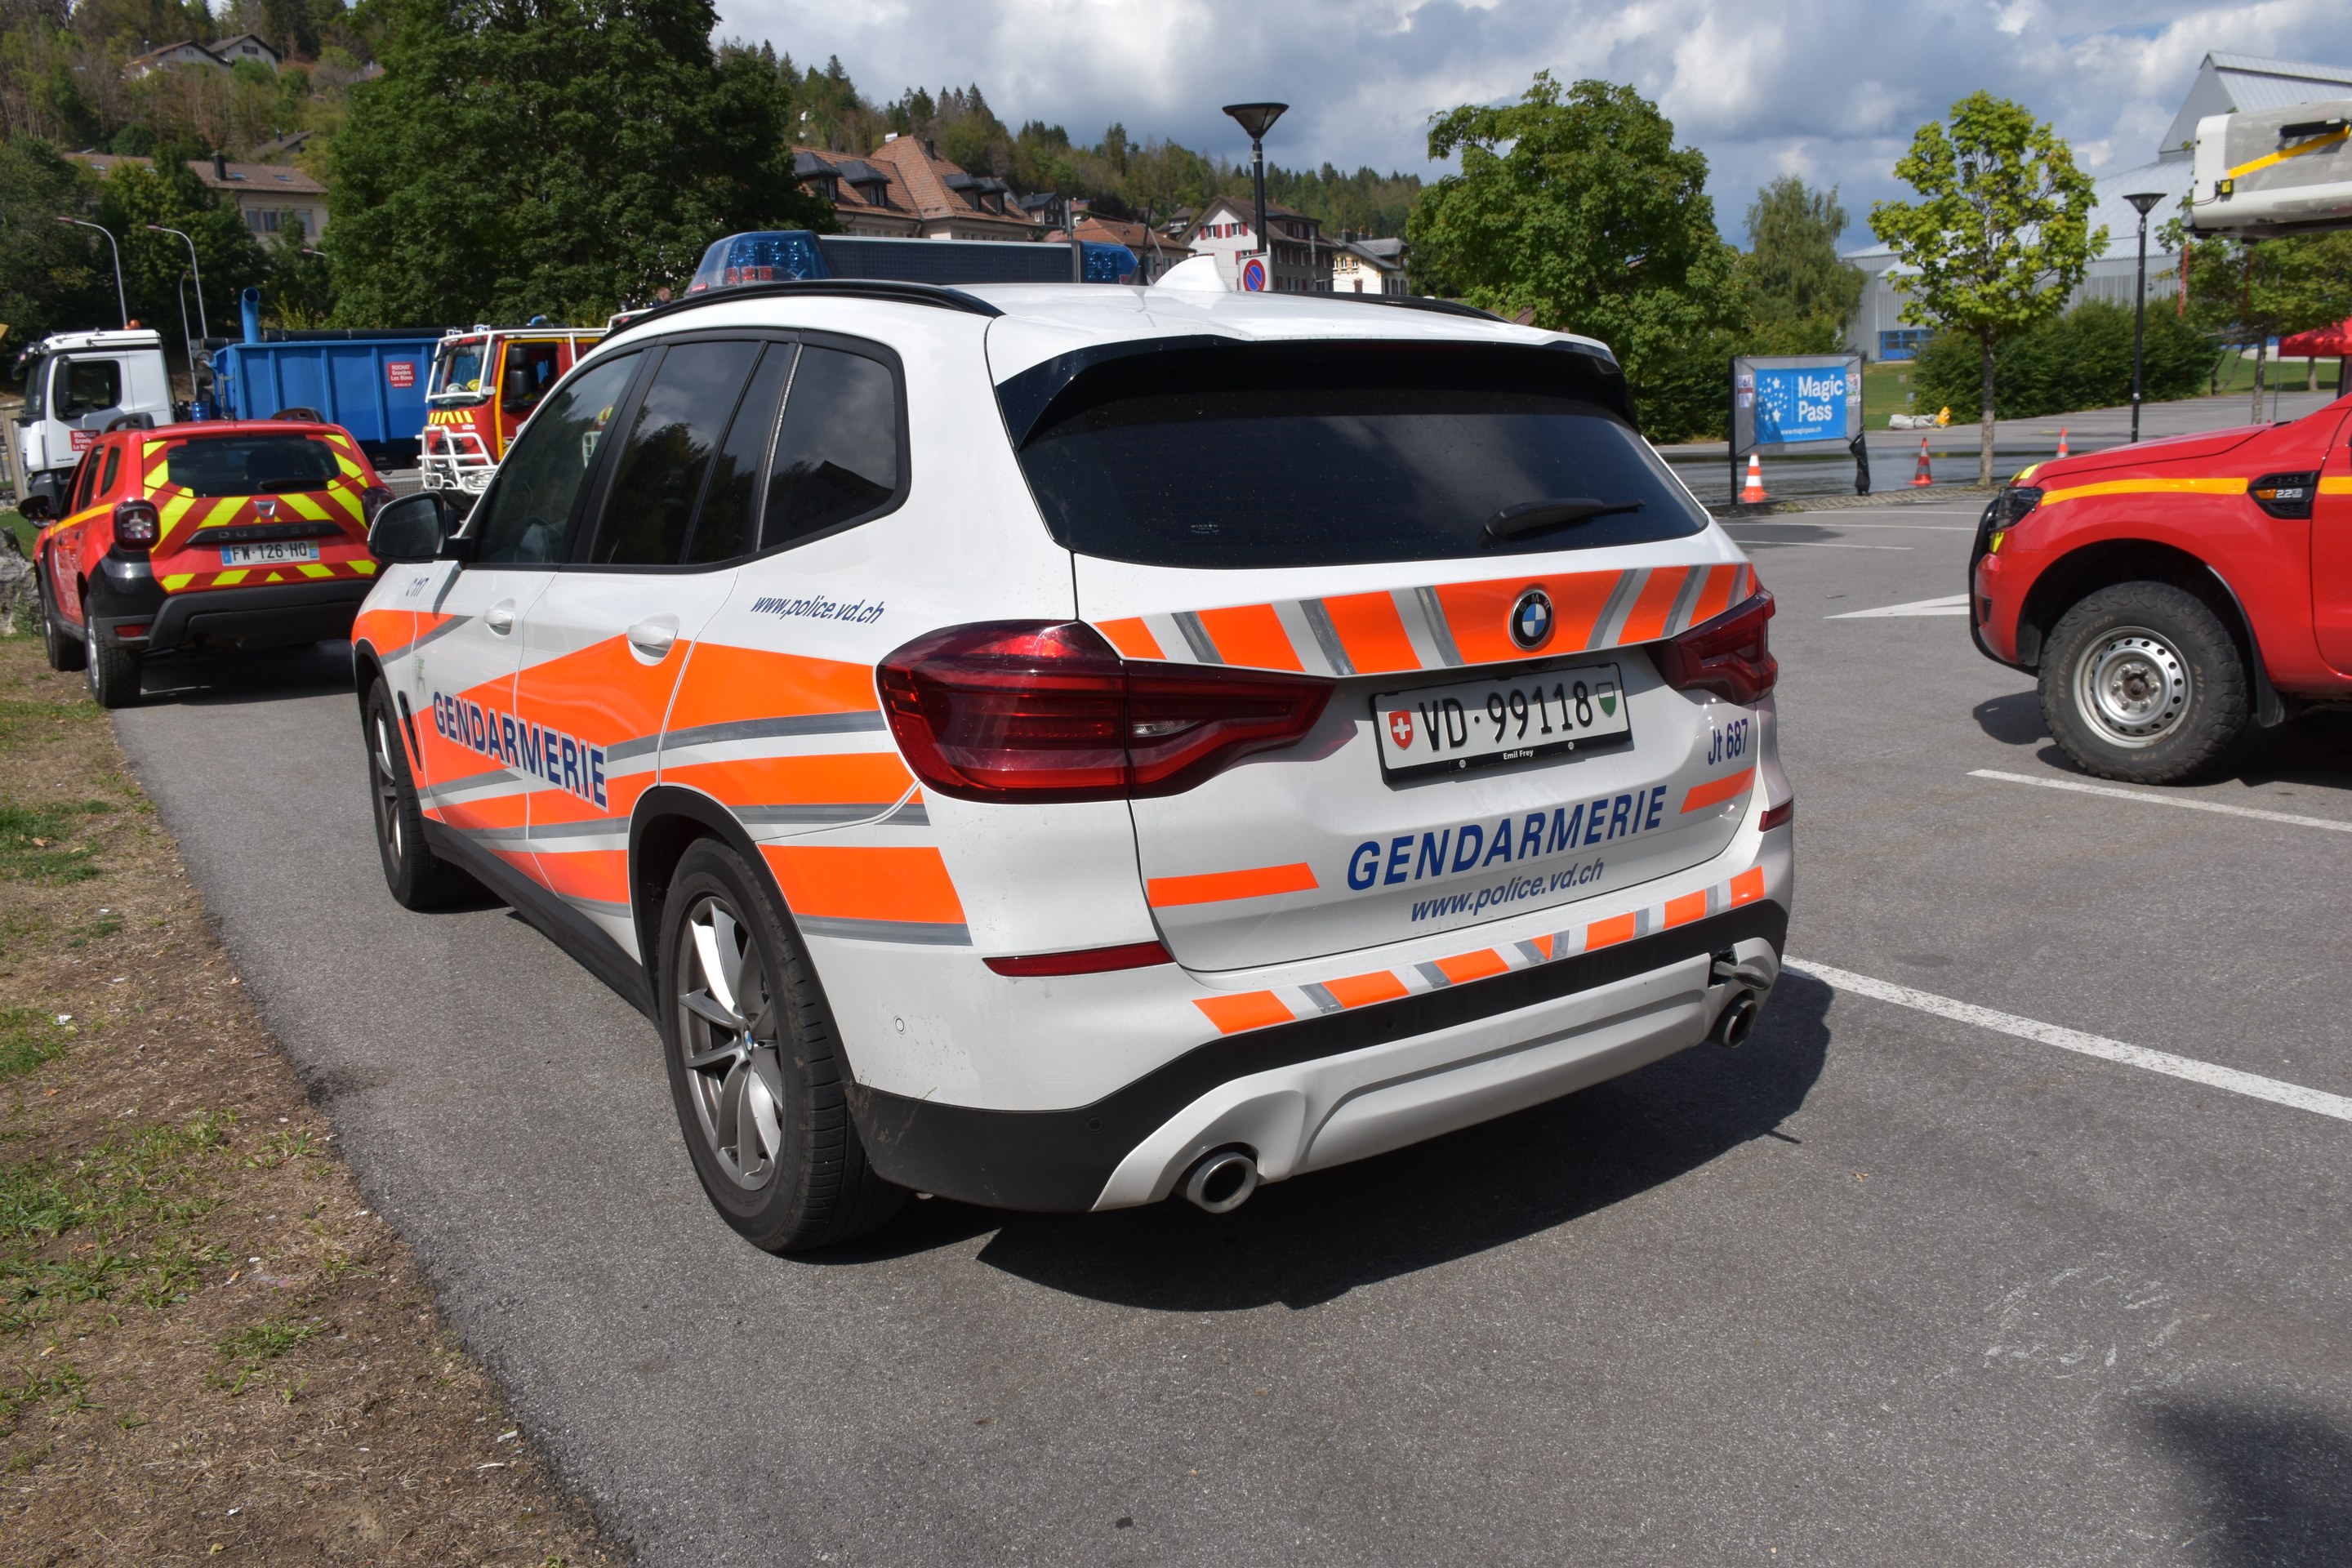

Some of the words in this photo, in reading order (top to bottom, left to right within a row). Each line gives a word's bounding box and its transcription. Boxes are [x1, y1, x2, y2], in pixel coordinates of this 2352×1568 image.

[1798, 374, 1843, 402] Magic
[1798, 401, 1833, 422] Pass
[218, 526, 318, 538] DUSTER
[751, 595, 884, 624] www.police.vd.ch
[1518, 594, 1550, 612] BMW
[433, 691, 608, 811] GENDARMERIE
[1726, 717, 1748, 760] 687
[1503, 751, 1518, 760] Emil
[1519, 749, 1534, 758] Frey
[1347, 785, 1668, 891] GENDARMERIE
[1410, 857, 1605, 922] www.police.vd.ch
